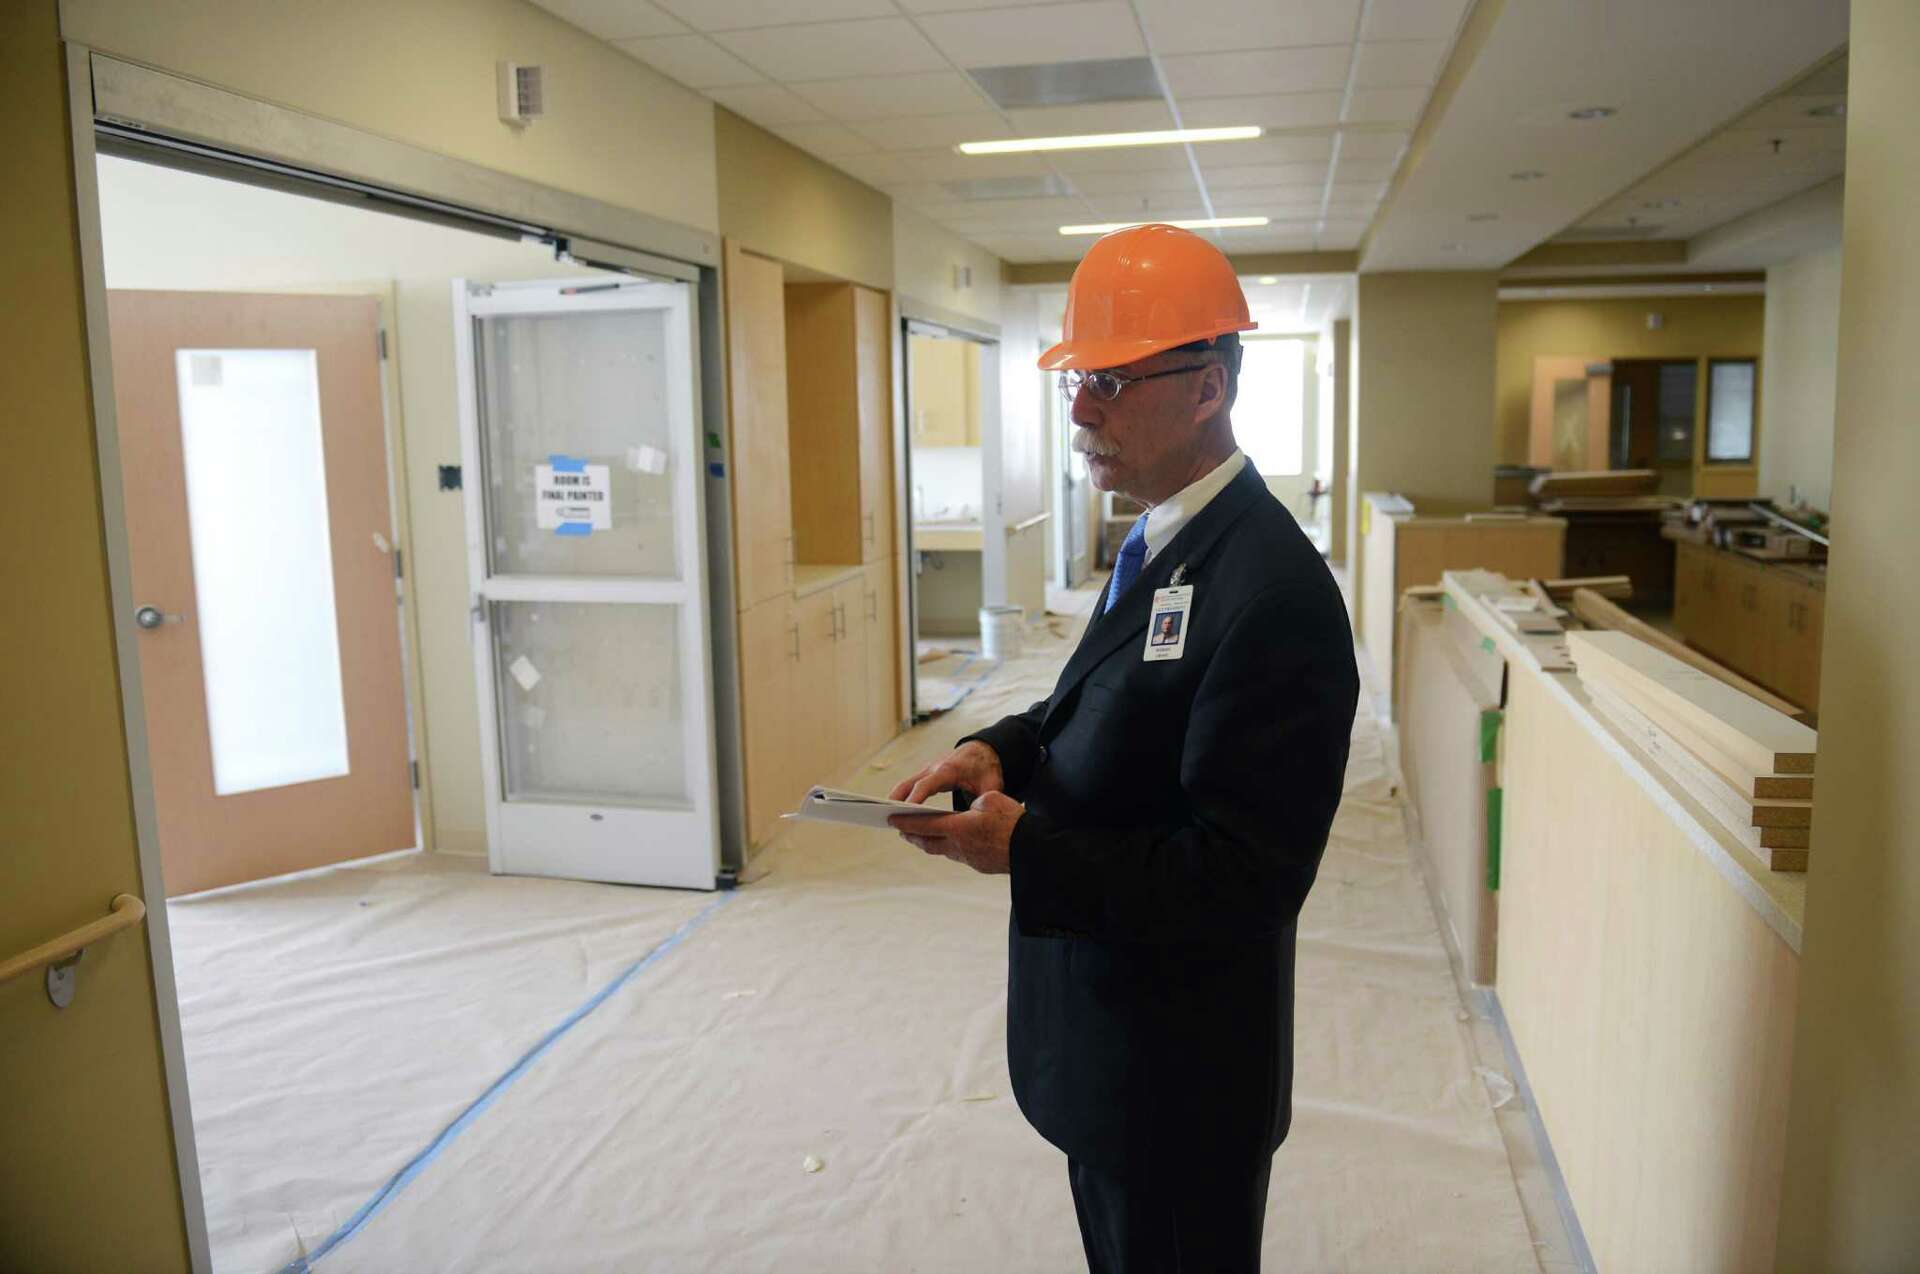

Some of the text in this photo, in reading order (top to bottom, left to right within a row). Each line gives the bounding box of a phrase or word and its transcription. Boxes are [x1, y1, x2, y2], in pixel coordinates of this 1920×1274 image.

[553, 475, 591, 486] ROOM IS
[542, 490, 564, 501] FINAL
